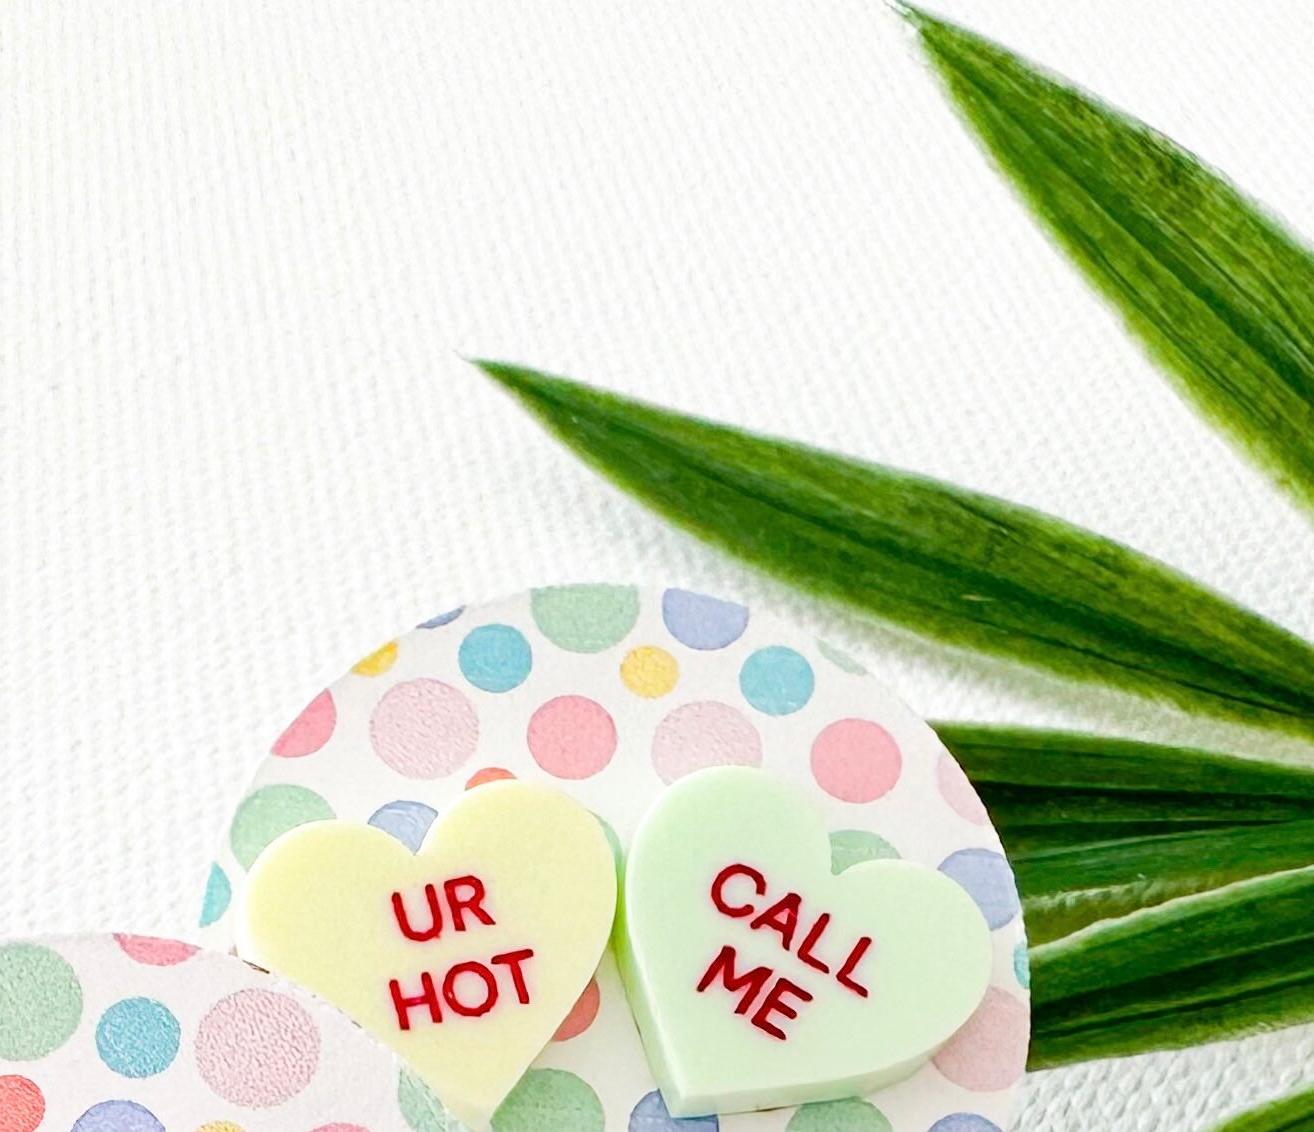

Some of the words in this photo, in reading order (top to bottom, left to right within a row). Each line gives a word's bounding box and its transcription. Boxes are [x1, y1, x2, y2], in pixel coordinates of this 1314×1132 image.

[390, 874, 496, 943] UR
[710, 863, 873, 1000] CALL
[388, 948, 534, 1031] HOT
[698, 945, 813, 1041] ME
